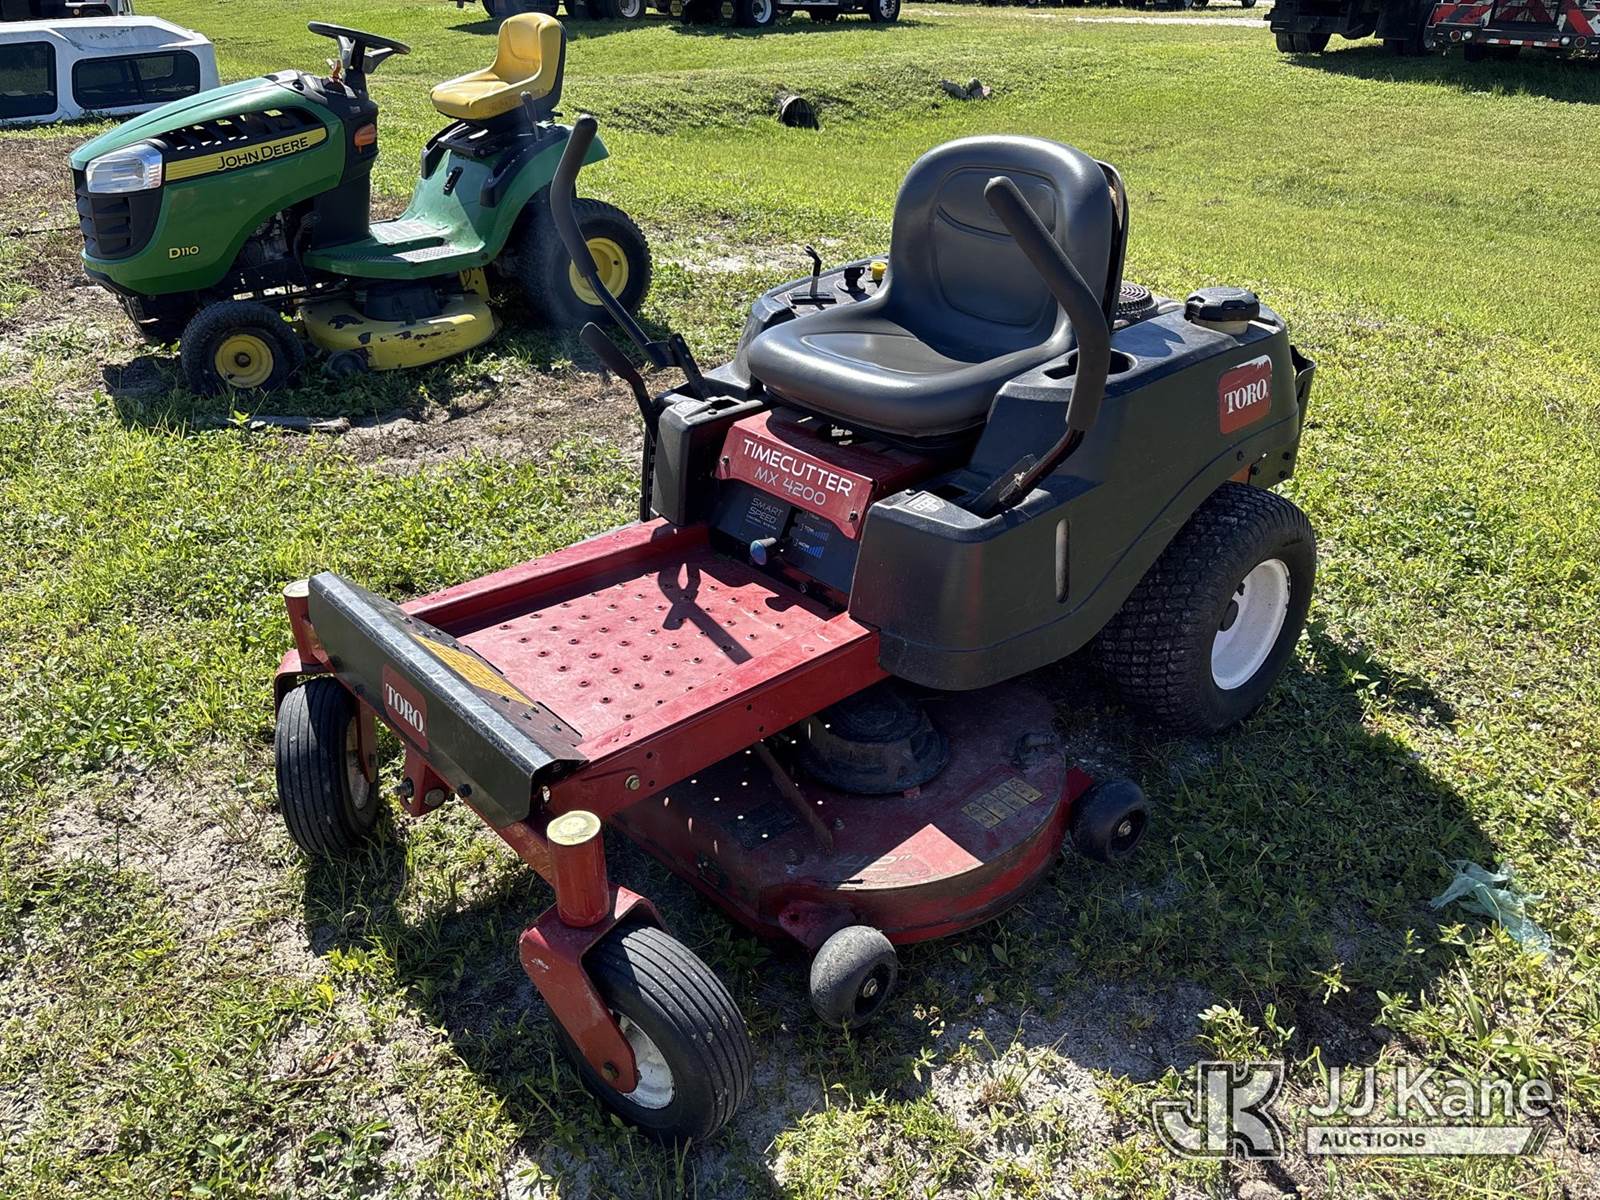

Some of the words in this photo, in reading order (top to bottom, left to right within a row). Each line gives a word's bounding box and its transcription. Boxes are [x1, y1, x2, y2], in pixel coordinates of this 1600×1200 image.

[217, 150, 260, 170] JOHN
[260, 136, 309, 159] DEERE
[169, 246, 199, 259] D110
[1224, 378, 1268, 414] TORO
[743, 438, 854, 497] TIMECUTTER
[754, 466, 780, 487] MX
[782, 477, 826, 506] 4200
[748, 506, 777, 524] SPEED
[751, 497, 784, 517] SMART
[385, 682, 424, 733] TORO
